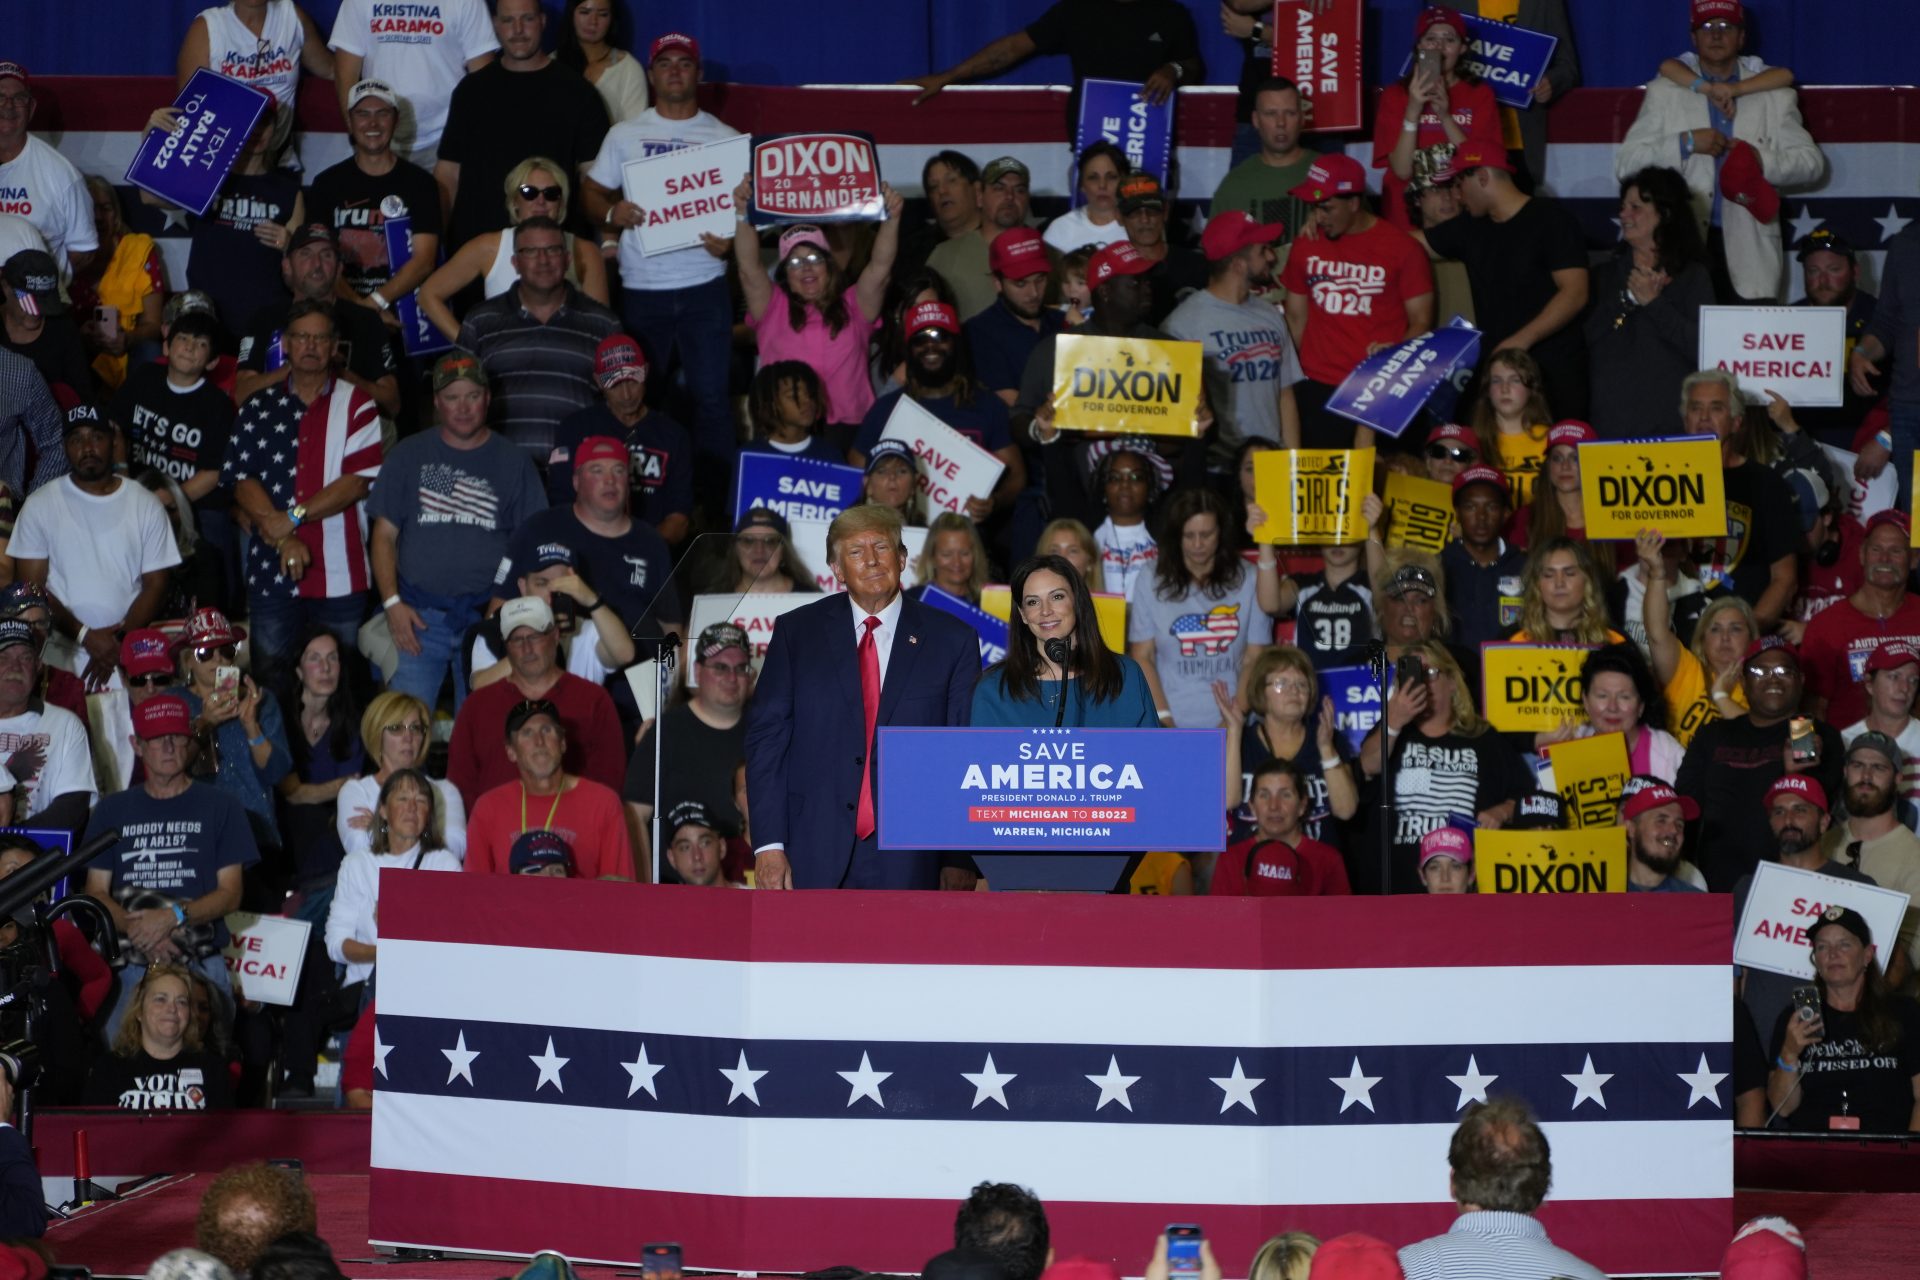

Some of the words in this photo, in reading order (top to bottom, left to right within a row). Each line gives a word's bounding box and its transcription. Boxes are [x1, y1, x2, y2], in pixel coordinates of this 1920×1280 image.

[373, 4, 440, 18] KRISTINA
[371, 18, 444, 35] KARAMO
[1470, 39, 1515, 62] AVE
[1296, 8, 1313, 121] AMERICA!
[1320, 32, 1339, 94] SAVE
[1467, 60, 1530, 88] RICA!
[185, 94, 207, 114] TO
[180, 110, 217, 167] RALLY
[1102, 117, 1121, 144] VE
[200, 127, 232, 171] TEXT
[761, 140, 871, 178] DIXON
[665, 168, 723, 195] SAVE
[774, 178, 791, 189] 20
[839, 174, 856, 186] 22
[762, 187, 873, 209] HERNANDEZ
[221, 198, 281, 220] RUMP
[334, 207, 387, 228] tru
[648, 193, 733, 227] AMERIC
[1098, 262, 1112, 278] 45
[1307, 255, 1386, 282] Trump
[1210, 329, 1281, 348] Trump
[1743, 333, 1806, 351] SAVE
[1388, 349, 1437, 399] SAVE
[1717, 360, 1832, 378] AMERICA!
[1073, 368, 1182, 404] DIXON
[68, 405, 98, 422] USA
[1083, 402, 1104, 413] FOR
[1107, 404, 1168, 417] GOVERNOR
[172, 423, 202, 448] GO
[912, 439, 960, 481] SAVE
[778, 476, 841, 502] SAVE
[1292, 477, 1350, 515] GIRLS
[1599, 474, 1705, 507] DIXON
[749, 496, 842, 522] AMERIC
[1612, 510, 1632, 520] FOR
[1635, 509, 1695, 520] GOVERNOR
[1403, 503, 1447, 550] GIRL
[0, 620, 28, 631] RUMP
[734, 617, 775, 632] SAV
[1314, 617, 1352, 650] 38
[980, 638, 1007, 663] VE
[1855, 637, 1879, 649] AUTO
[1506, 676, 1583, 704] DIXO
[1518, 707, 1540, 715] FOR
[1019, 742, 1085, 760] SAVE
[1404, 743, 1477, 764] JESUS
[1403, 758, 1413, 768] IS
[1416, 757, 1433, 769] MY
[1435, 762, 1478, 774] SAVIOR
[960, 763, 1144, 790] AMERICA
[1775, 778, 1807, 791] MAGA
[981, 794, 1033, 802] PRESIDENT
[1036, 794, 1076, 802] DONALD
[1080, 794, 1087, 802] J.
[1090, 794, 1122, 802] TRUMP
[976, 809, 1005, 819] TEXT
[1009, 810, 1068, 819] MICHIGAN
[1073, 810, 1088, 819] TO
[1091, 810, 1128, 819] 88022
[122, 823, 164, 838] NOBODY
[166, 822, 202, 834] NEEDS
[993, 827, 1047, 838] WARREN,
[1051, 827, 1111, 837] MICHIGAN
[133, 836, 148, 849] AN
[151, 834, 187, 847] AR15?
[133, 862, 157, 871] NOBODY
[158, 861, 177, 870] NEEDS
[139, 871, 157, 879] LITTLE
[158, 870, 174, 879] BITCH
[1257, 863, 1292, 880] MAGA
[158, 879, 169, 887] YOU
[1495, 861, 1607, 893] DIXON
[231, 933, 263, 952] VE
[224, 956, 286, 980] RICA!
[1817, 1058, 1871, 1072] PISSED
[1873, 1056, 1898, 1069] OFF
